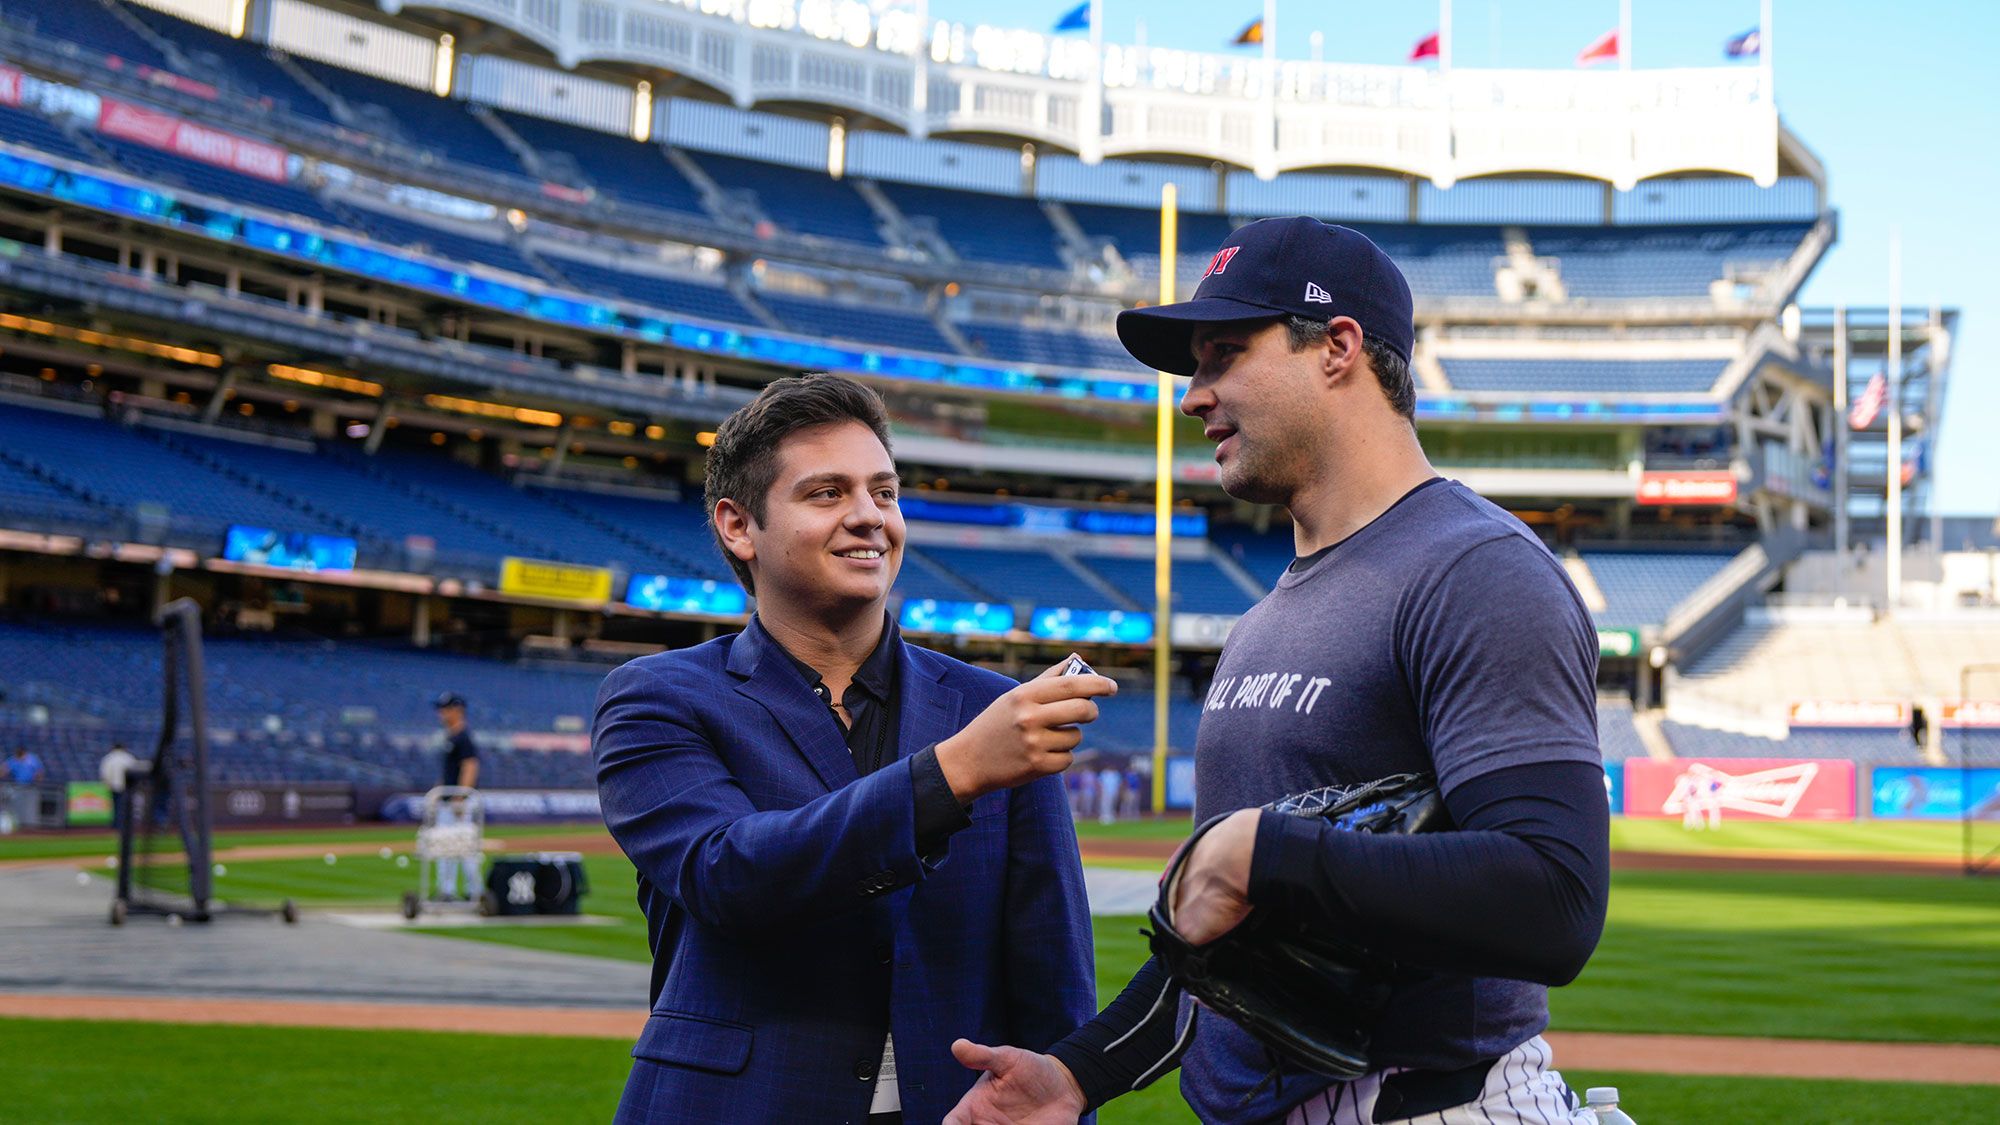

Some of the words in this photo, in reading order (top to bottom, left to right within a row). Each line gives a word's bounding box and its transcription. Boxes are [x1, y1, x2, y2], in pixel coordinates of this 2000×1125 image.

[1201, 246, 1240, 280] Y
[1230, 672, 1277, 709] PART
[1269, 673, 1302, 709] OF
[1295, 676, 1332, 715] IT
